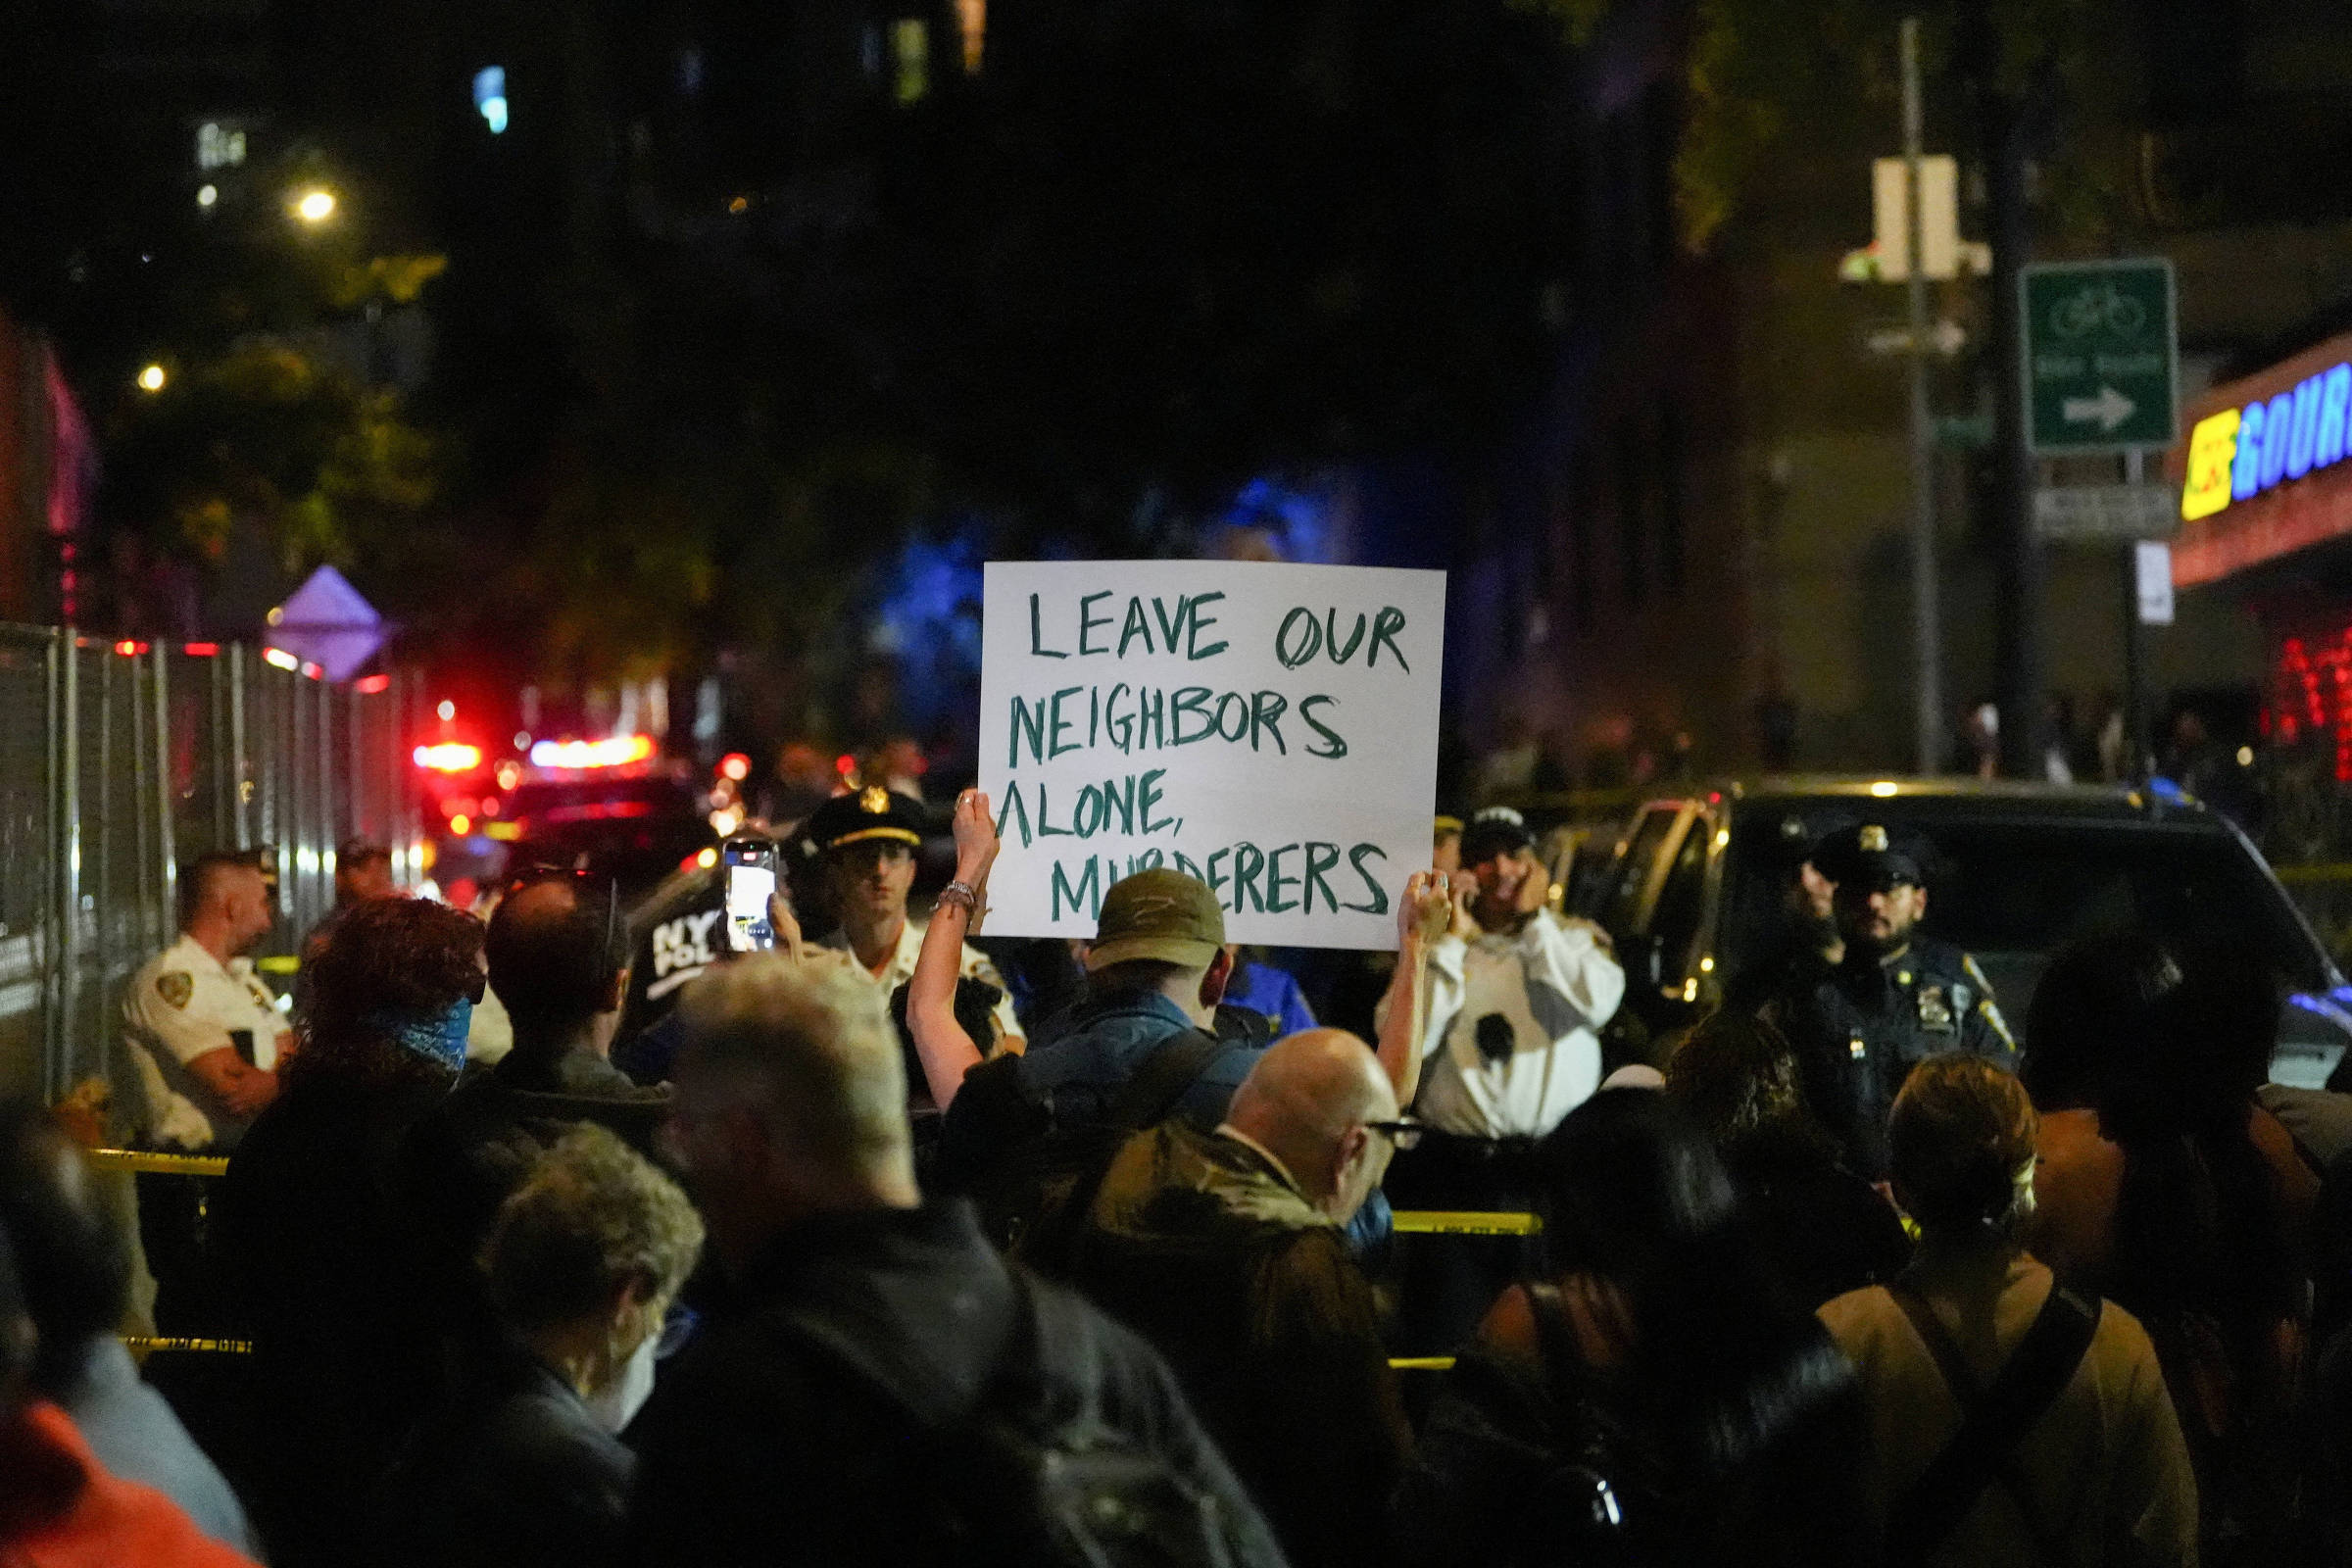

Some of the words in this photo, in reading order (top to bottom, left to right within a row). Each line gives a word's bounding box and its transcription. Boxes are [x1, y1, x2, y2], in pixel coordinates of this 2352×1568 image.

[2231, 362, 2352, 501] GOUR
[1030, 590, 1230, 661] LEAVE
[1276, 606, 1410, 674] OUR
[1009, 683, 1348, 768] NEIGHBORS
[995, 768, 1184, 848] ALONE,
